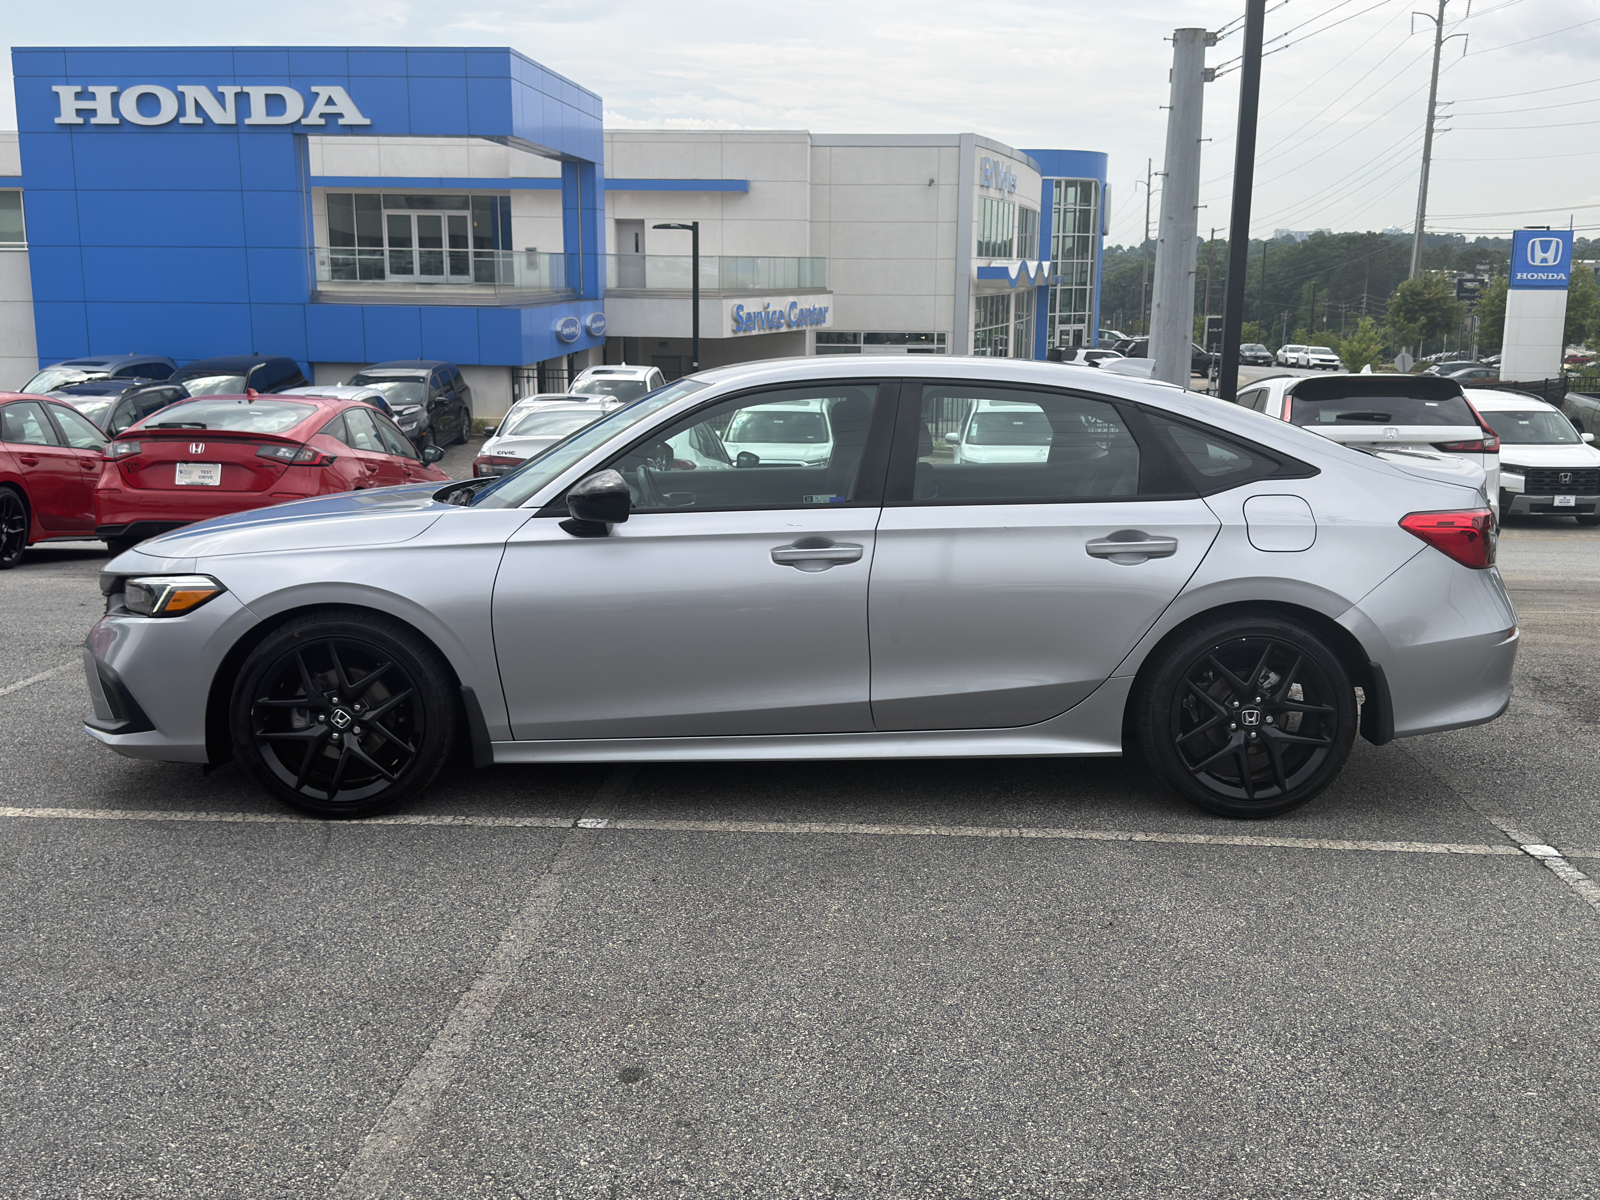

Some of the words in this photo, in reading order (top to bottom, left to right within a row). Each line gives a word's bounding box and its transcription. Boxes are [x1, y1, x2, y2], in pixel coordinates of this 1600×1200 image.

[52, 85, 371, 126] HONDA
[1515, 272, 1567, 280] HONDA
[731, 302, 785, 333] Service
[785, 300, 829, 328] Center
